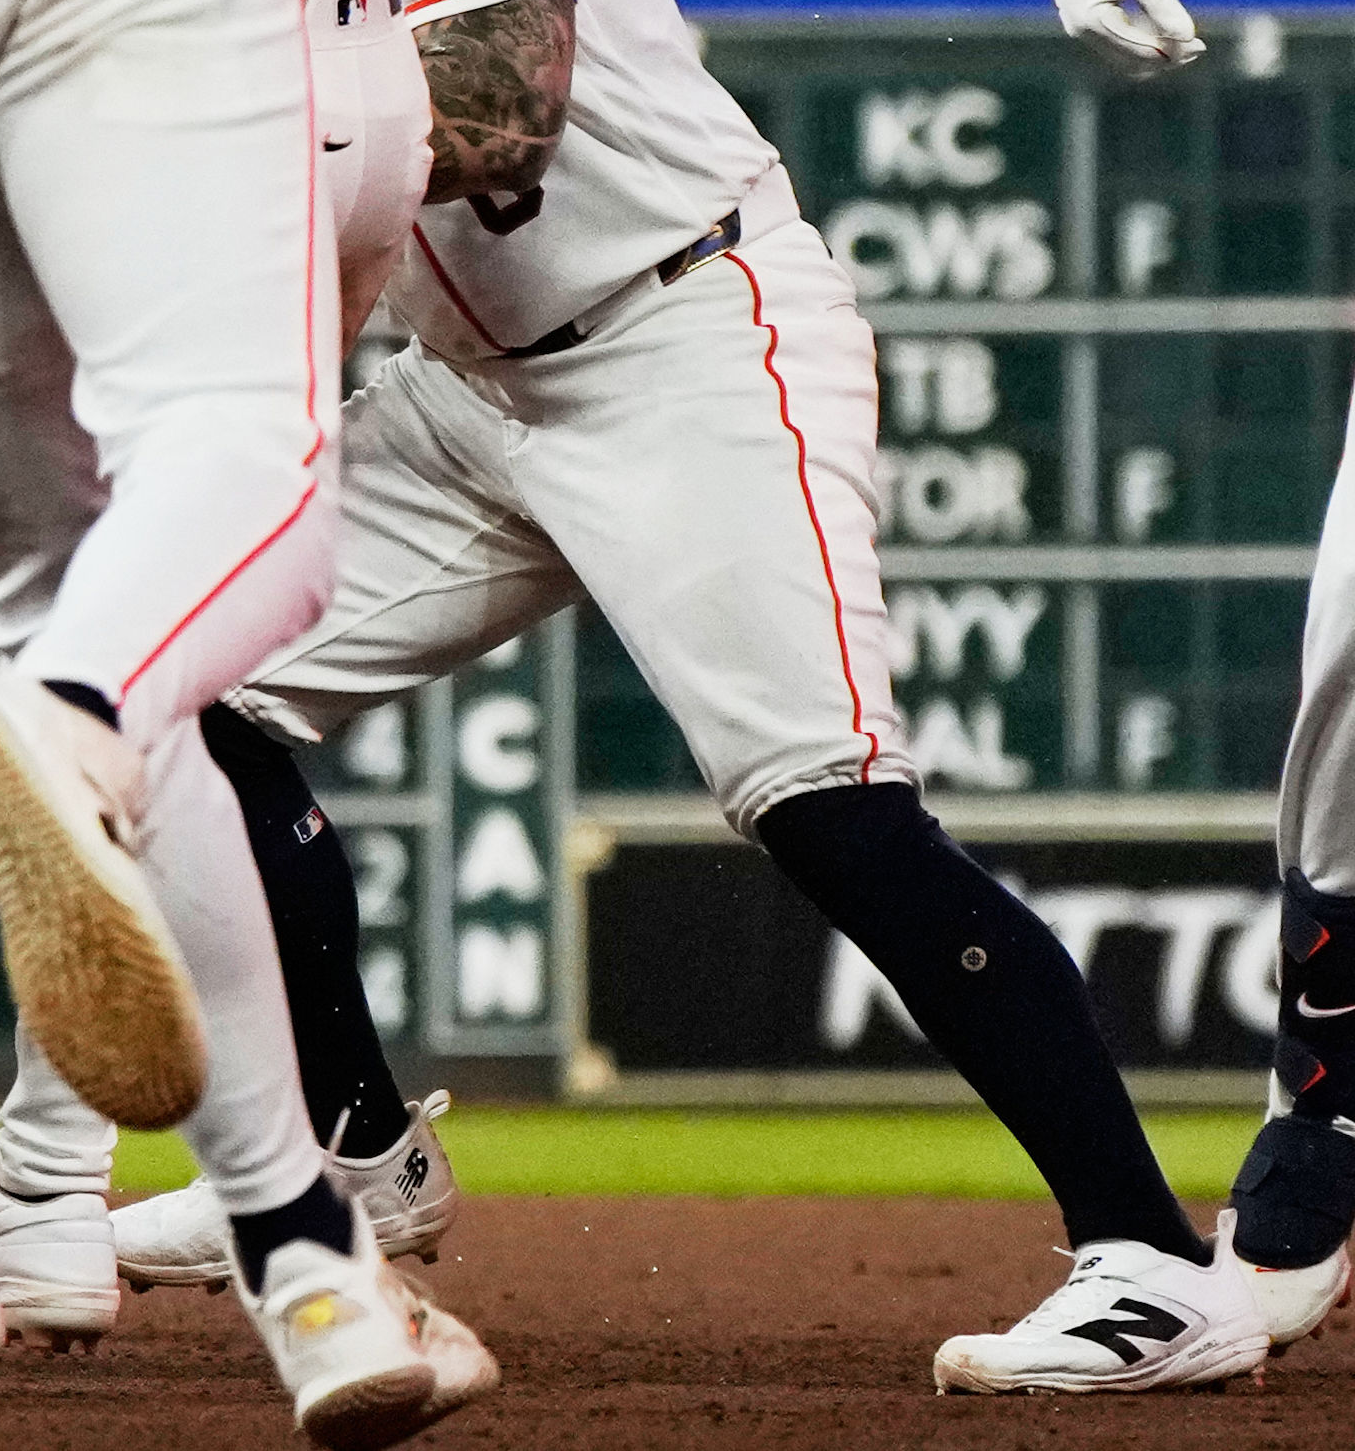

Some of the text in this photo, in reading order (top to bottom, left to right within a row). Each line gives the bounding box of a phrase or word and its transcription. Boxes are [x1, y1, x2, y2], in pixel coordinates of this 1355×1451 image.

[860, 86, 1005, 189] KC
[826, 199, 1054, 299] CWS
[909, 696, 1032, 790] AL
